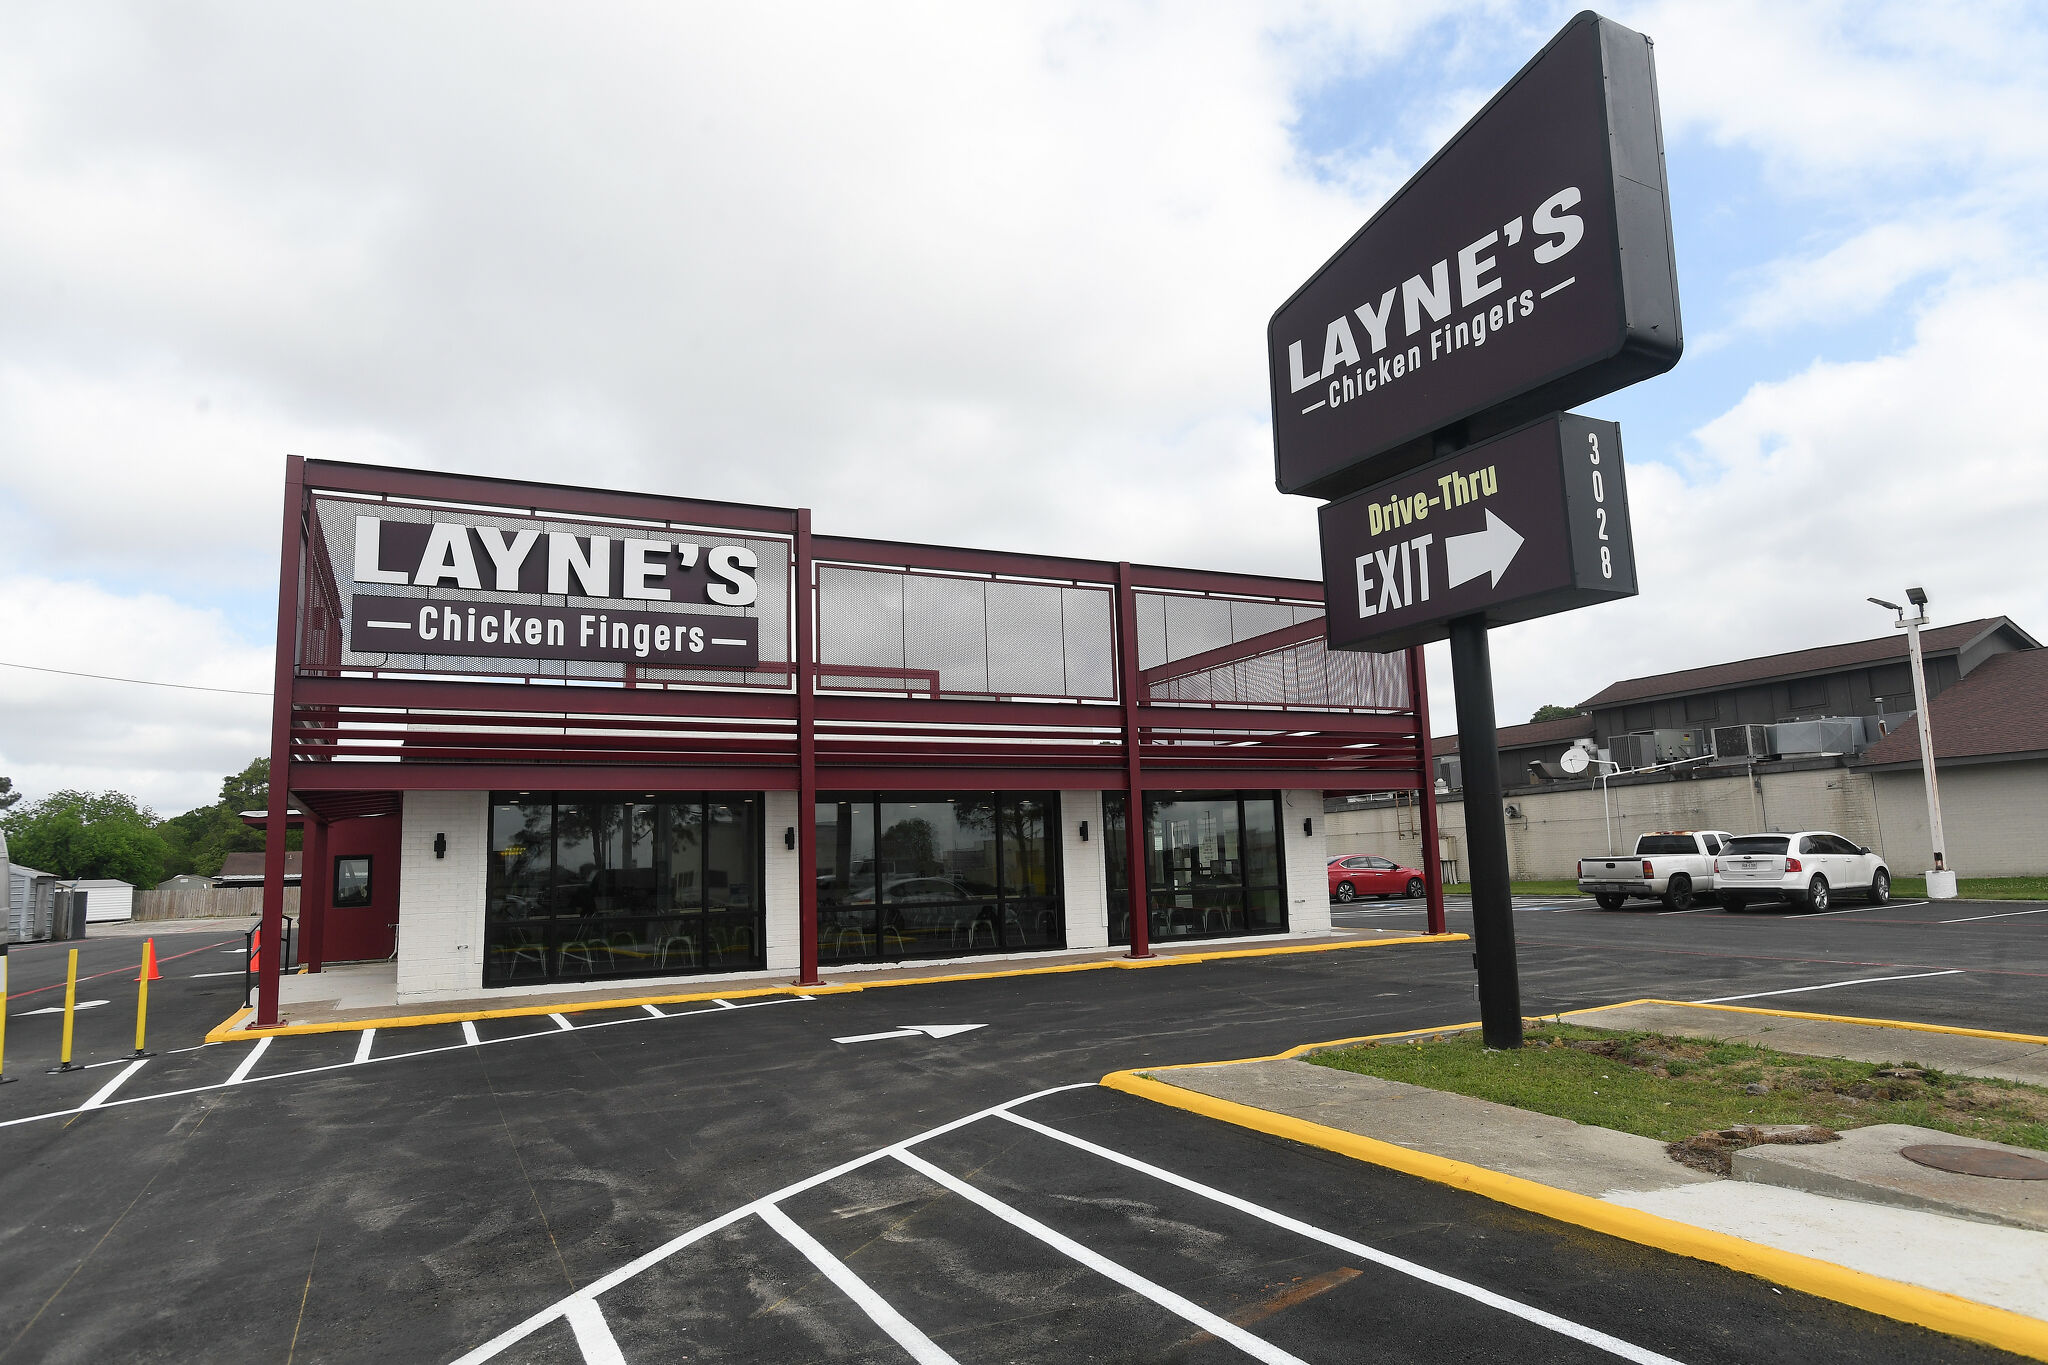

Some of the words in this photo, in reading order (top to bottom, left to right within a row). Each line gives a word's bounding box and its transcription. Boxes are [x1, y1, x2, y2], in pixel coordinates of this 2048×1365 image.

[1288, 186, 1585, 394] LAYNE'S
[1328, 344, 1421, 408] Chicken
[1430, 288, 1534, 361] Fingers
[1368, 464, 1498, 537] Drive-Thru
[1587, 432, 1613, 579] 3028
[354, 515, 758, 606] LAYNE'S
[1355, 533, 1433, 619] EXIT
[418, 605, 565, 647] Chicken
[580, 615, 705, 657] Fingers
